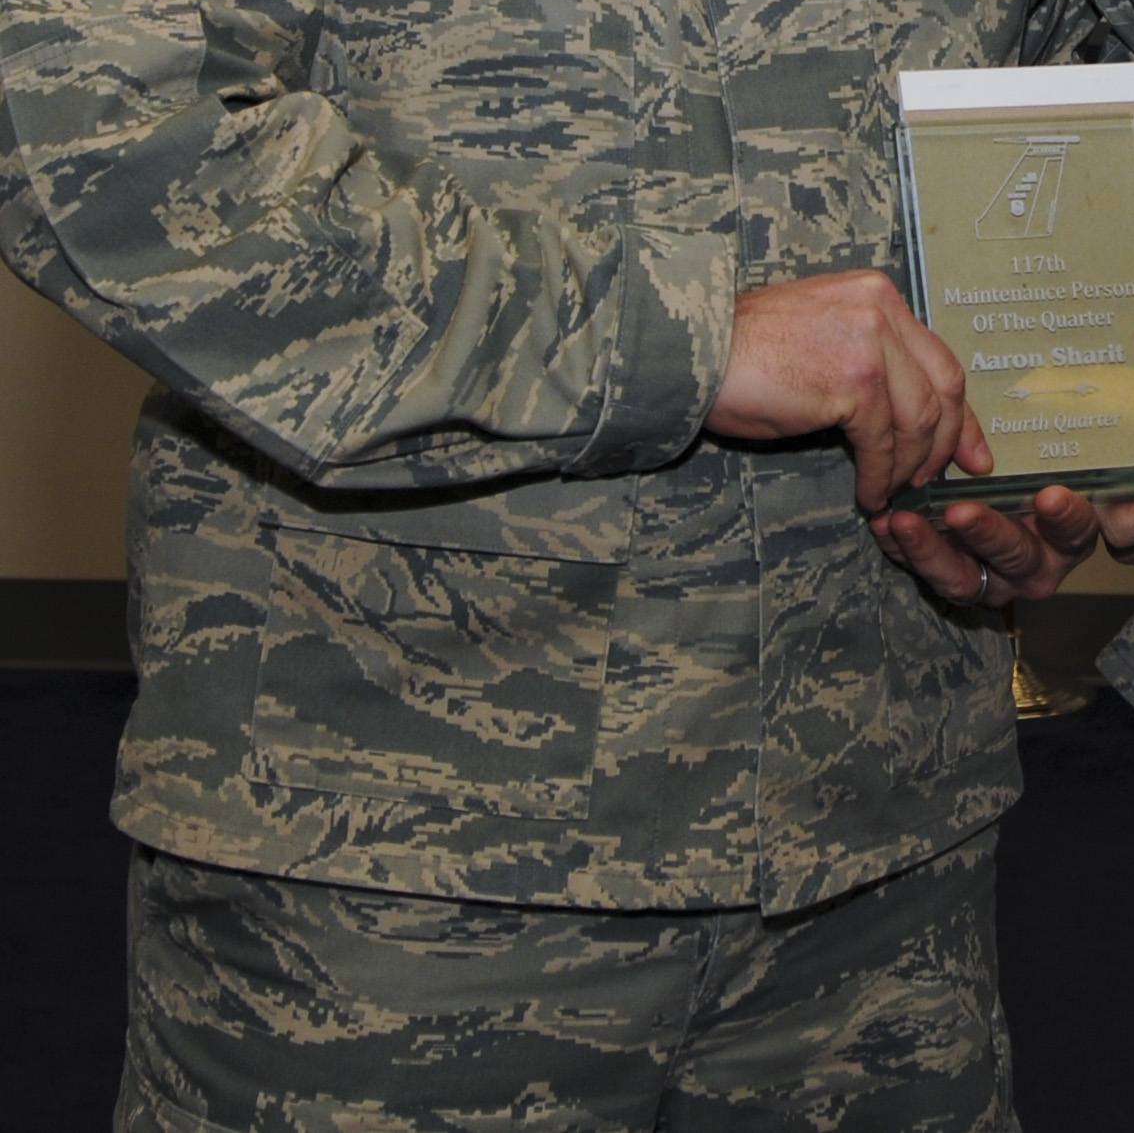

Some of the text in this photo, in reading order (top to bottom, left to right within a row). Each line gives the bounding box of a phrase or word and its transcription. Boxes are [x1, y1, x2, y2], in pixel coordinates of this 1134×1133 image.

[1010, 255, 1066, 275] 117th
[943, 286, 1066, 308] Maintenance
[972, 310, 1116, 334] Of The Quarter
[969, 344, 1127, 373] Aaron Sharit
[989, 413, 1121, 436] Fourth Quarter
[1038, 442, 1080, 460] 2013
